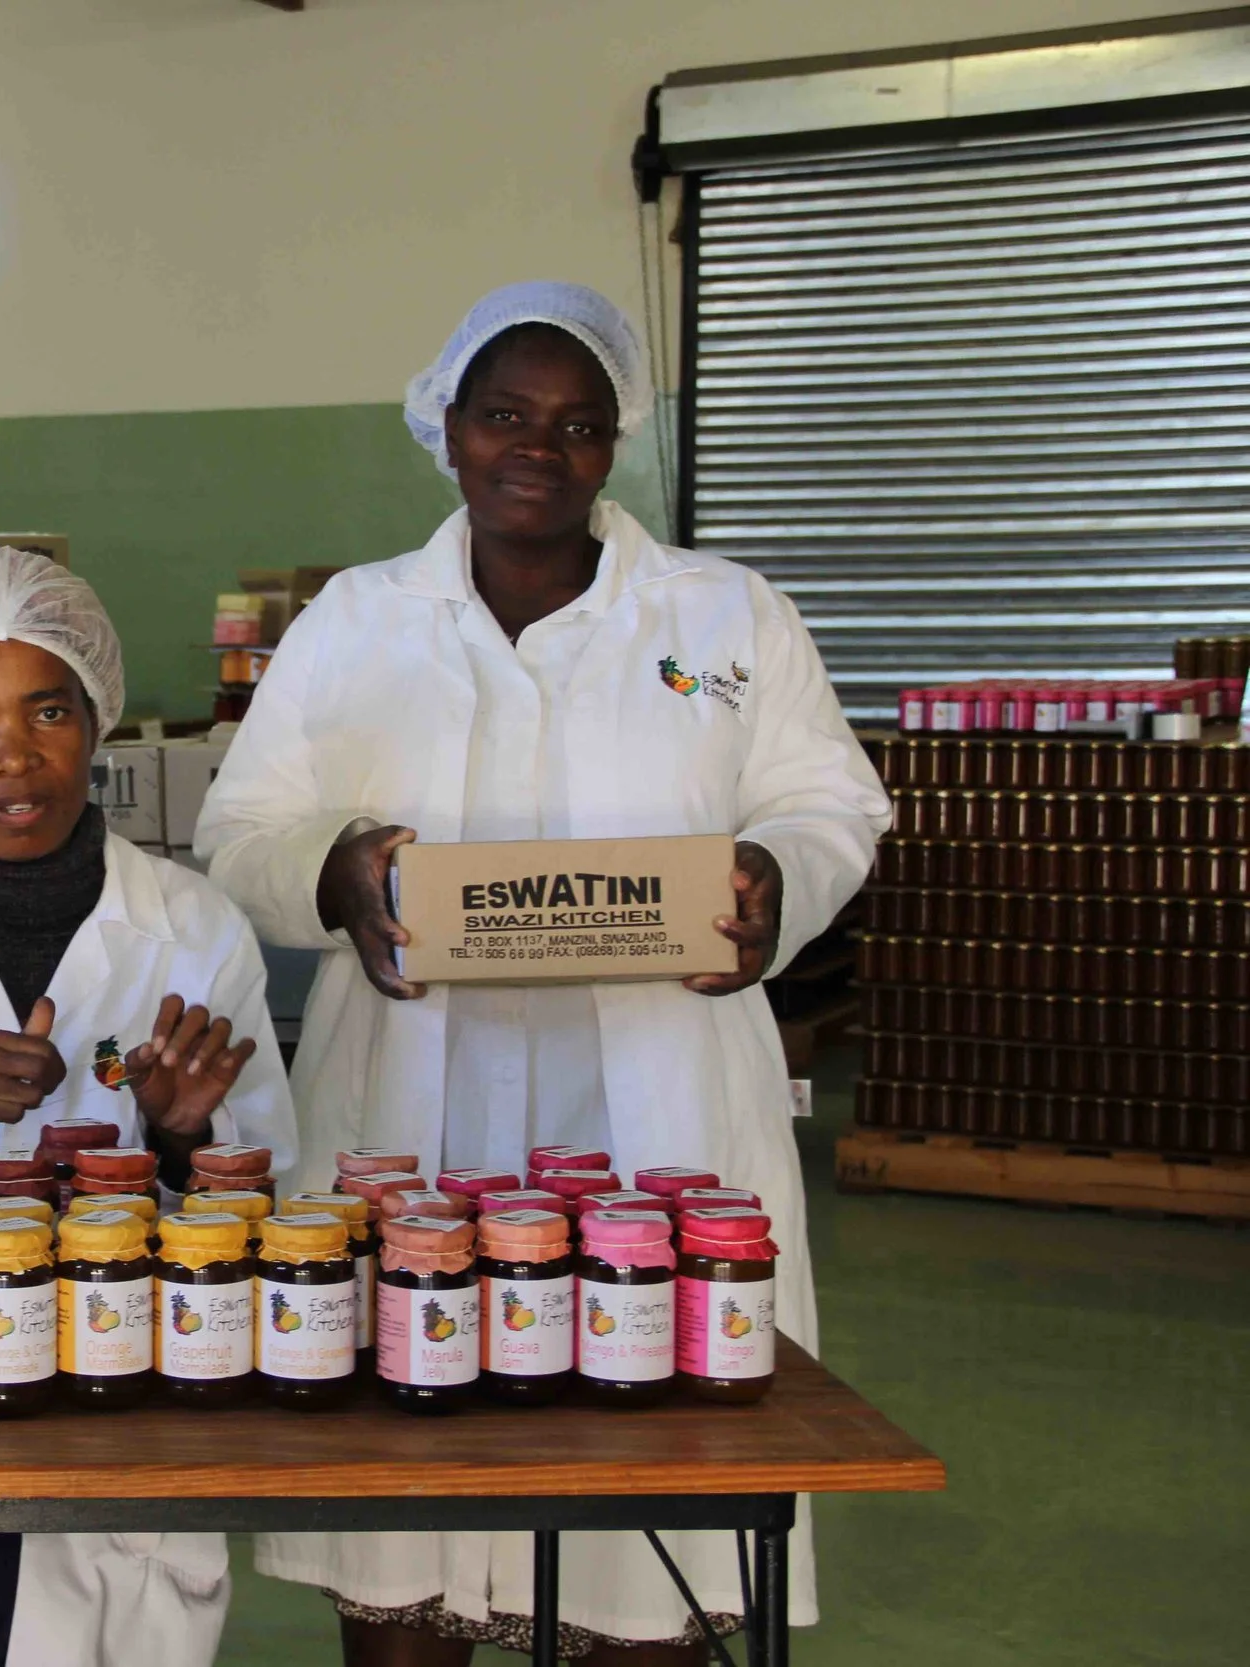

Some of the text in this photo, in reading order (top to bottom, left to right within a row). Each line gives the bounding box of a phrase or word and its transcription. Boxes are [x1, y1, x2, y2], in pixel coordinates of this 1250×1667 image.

[462, 873, 661, 910] ESWATINI
[465, 910, 661, 928] SWAZI KITCHEN
[488, 936, 512, 947] BOX
[600, 931, 668, 944] SWAZILAND
[449, 948, 476, 958] TEL:
[87, 1340, 133, 1359] Orange
[170, 1342, 233, 1363] Grapefruit
[501, 1337, 540, 1354] Guava
[716, 1342, 755, 1361] Mango
[421, 1346, 463, 1363] Marula
[500, 1354, 525, 1368] Jam
[87, 1356, 144, 1371] Marmalade
[170, 1358, 231, 1374] Marmalade
[422, 1363, 446, 1382] Jelly
